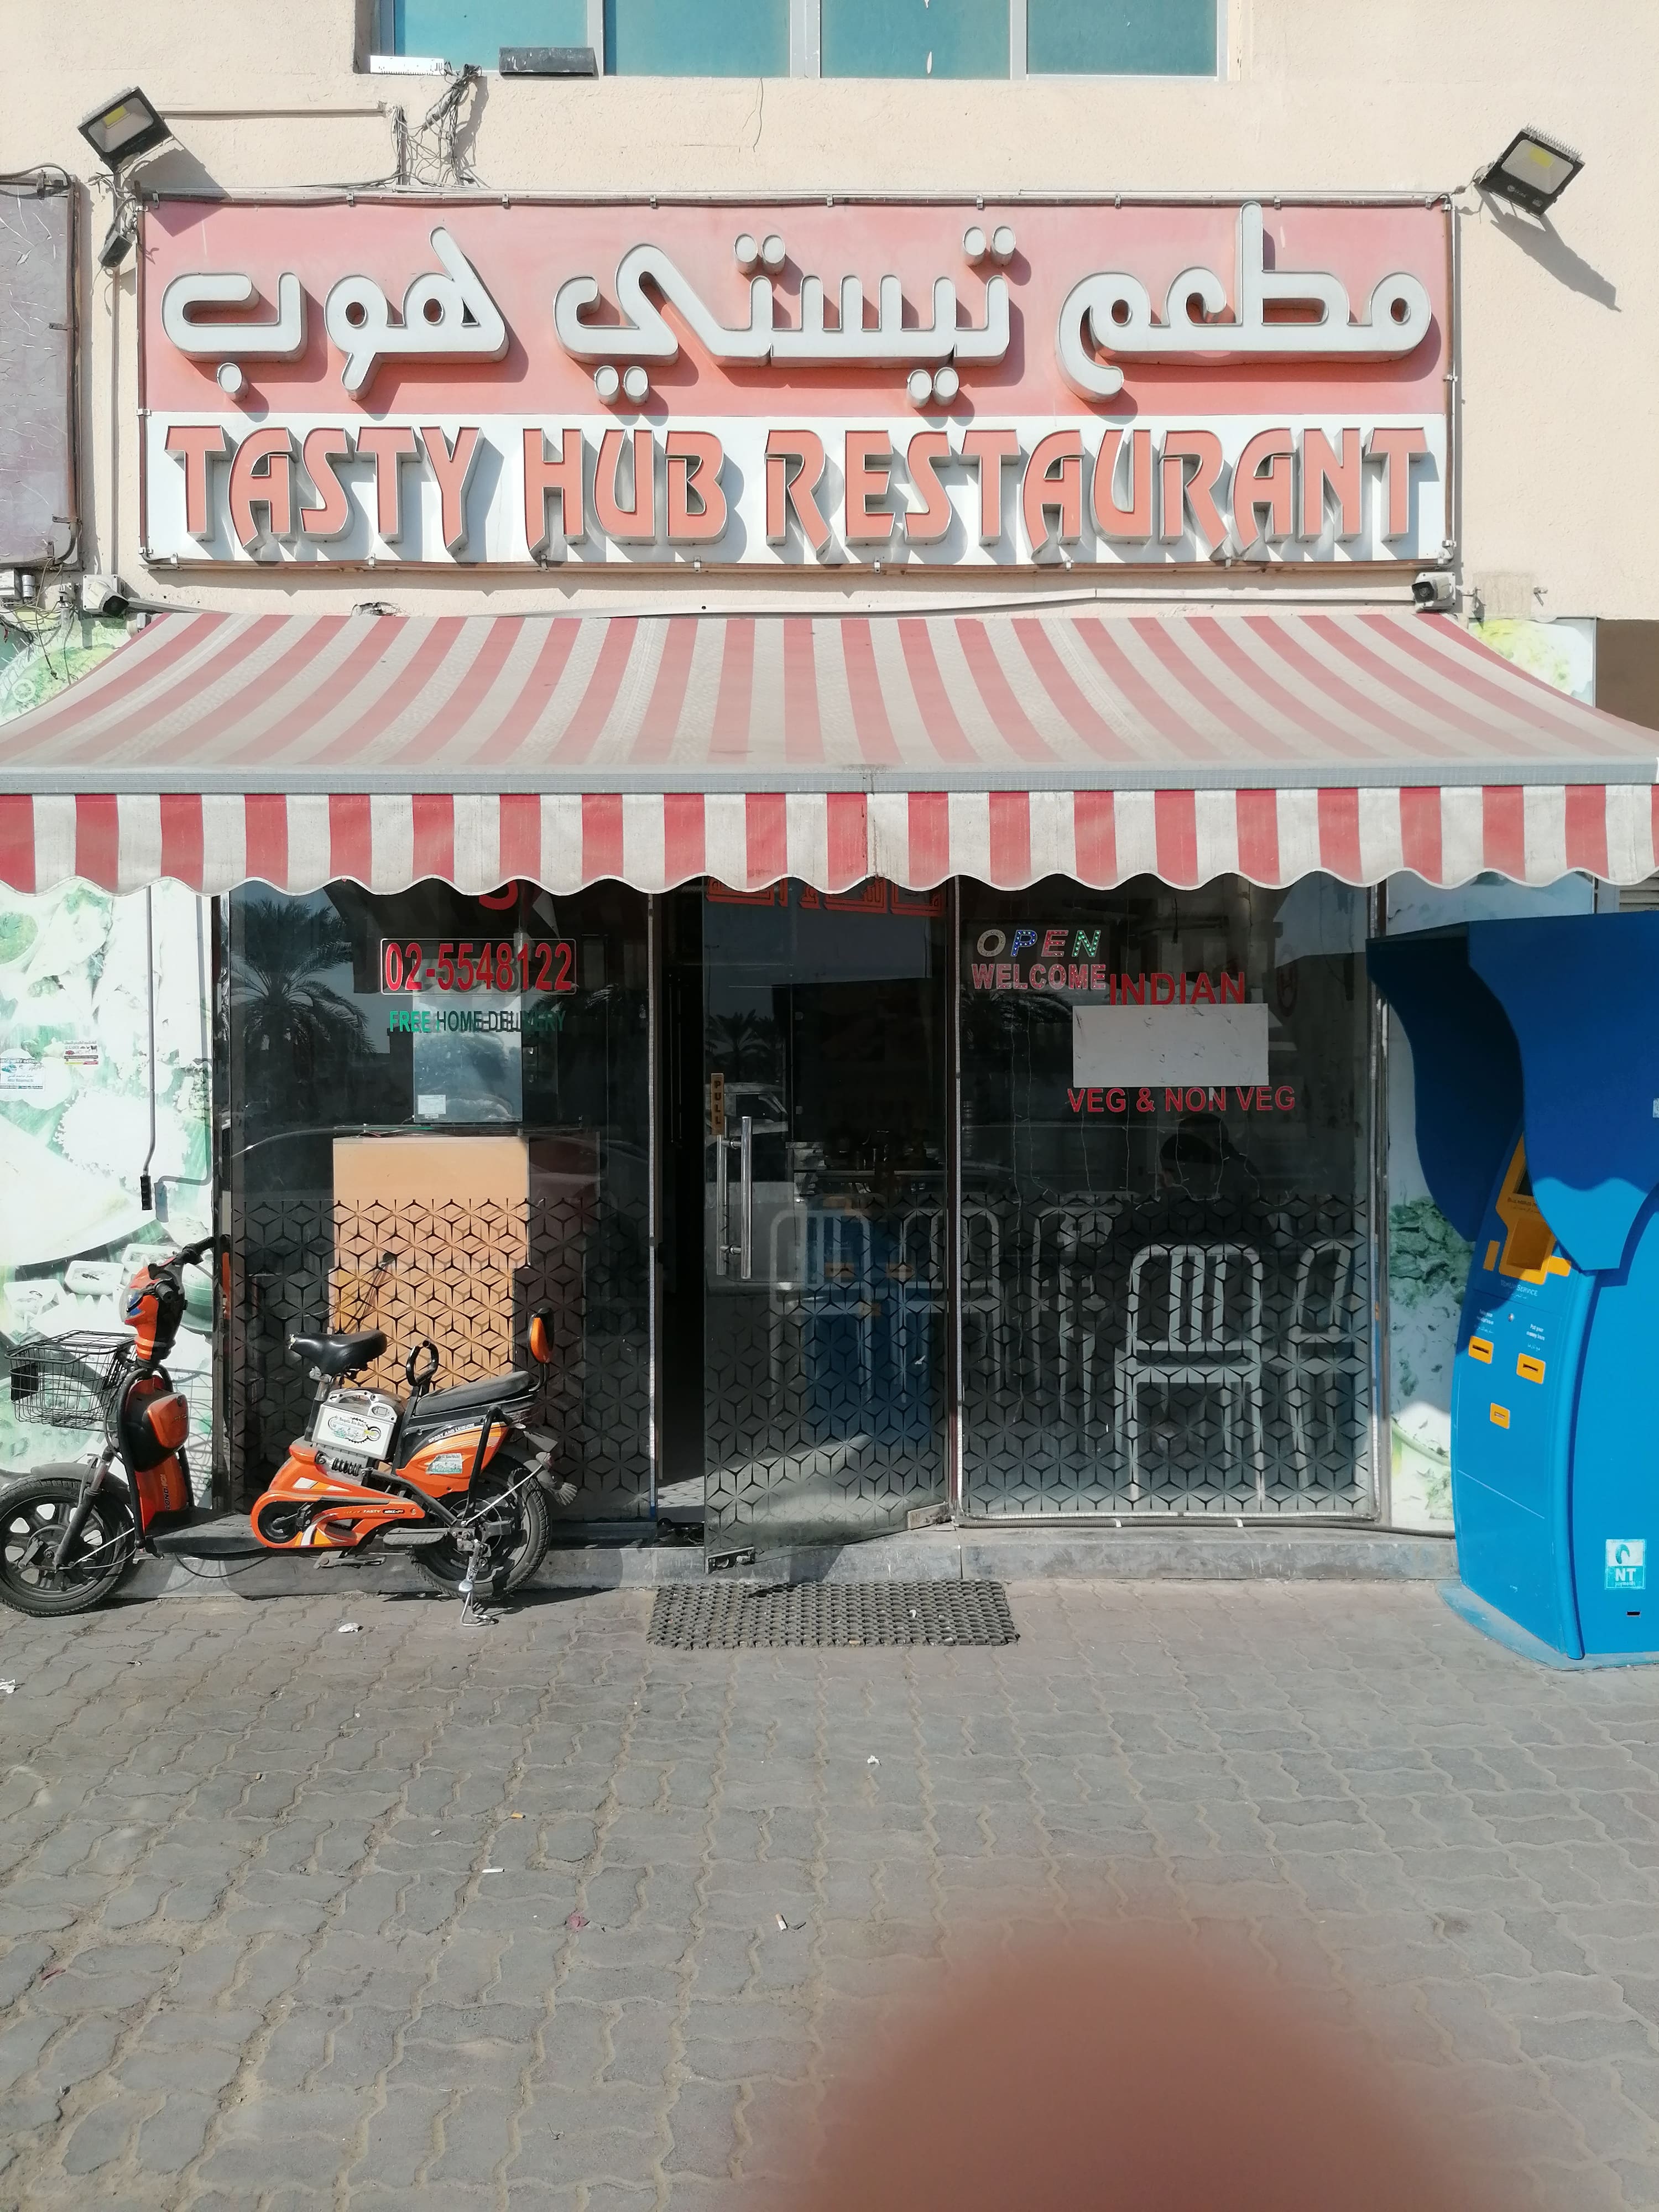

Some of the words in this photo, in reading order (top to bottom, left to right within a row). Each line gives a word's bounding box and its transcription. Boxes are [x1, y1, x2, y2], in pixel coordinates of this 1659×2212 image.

[161, 226, 507, 399] هوب
[554, 226, 1015, 406] تيستي
[1057, 201, 1432, 401] مطعم
[165, 425, 484, 554] TASTY
[523, 428, 727, 555] HUB
[765, 427, 1429, 556] RESTAURANT
[977, 929, 1101, 957] OPEN
[385, 942, 572, 991] 02-5548122
[972, 963, 1106, 990] WELCOME
[1109, 972, 1245, 1005] INDIAN
[389, 1010, 431, 1032] FREE
[437, 1010, 482, 1032] HOME
[488, 1010, 566, 1032] DELIVERY
[1067, 1087, 1126, 1113] VEG
[1136, 1087, 1155, 1113] &
[1165, 1087, 1226, 1112] NON
[1235, 1086, 1295, 1111] VEG
[428, 1433, 444, 1443] SPORT
[1615, 1568, 1637, 1582] NT
